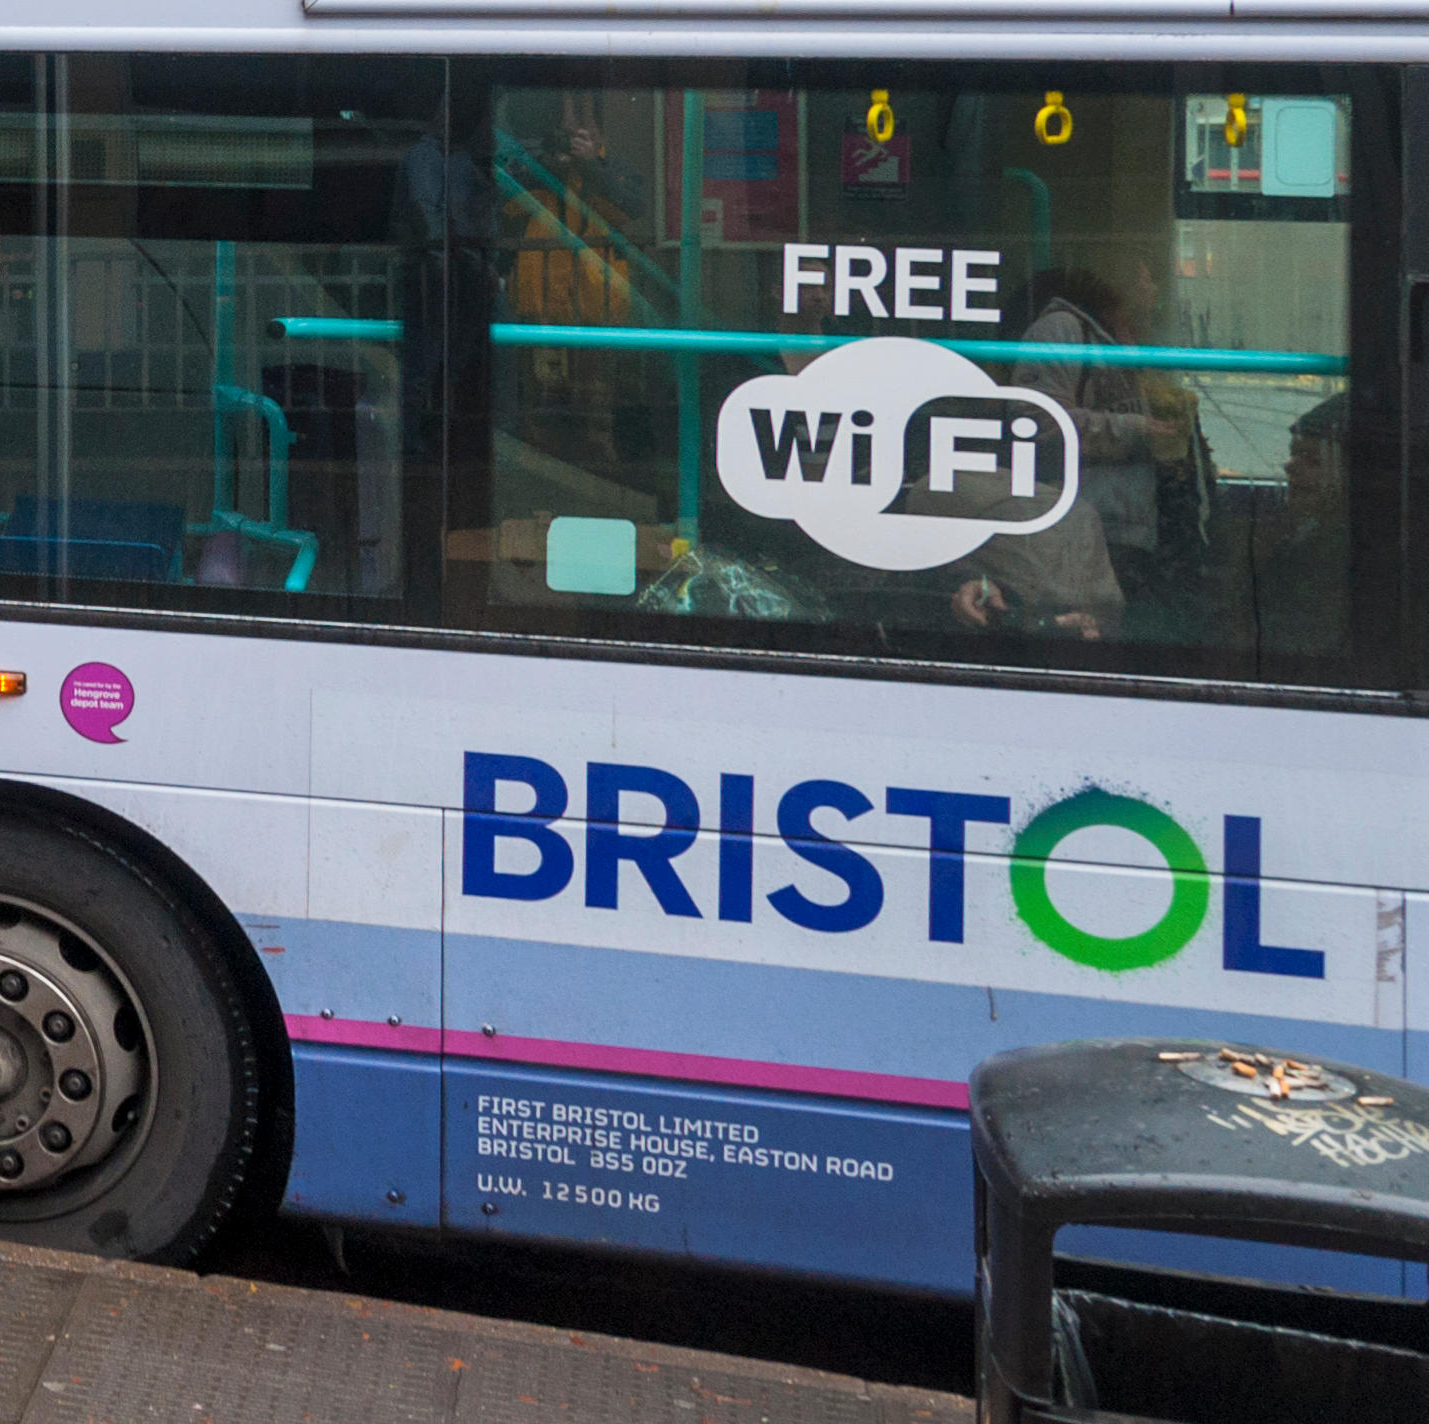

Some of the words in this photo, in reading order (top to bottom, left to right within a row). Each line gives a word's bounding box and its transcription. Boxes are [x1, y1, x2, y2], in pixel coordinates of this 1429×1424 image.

[783, 243, 1001, 323] FREE
[70, 698, 98, 709] depot
[100, 700, 124, 710] team
[73, 688, 120, 700] Hengrove
[461, 750, 1326, 980] BRISTOL
[478, 1096, 546, 1120] FIRST
[552, 1104, 653, 1131] BRISTOL
[659, 1116, 760, 1144] LIMITED
[478, 1117, 622, 1150] ENTERPRISE
[630, 1134, 715, 1163] HOUSE,
[723, 1146, 818, 1174] EASTON
[826, 1156, 894, 1181] ROAD
[478, 1138, 577, 1166] BRISTOL
[590, 1149, 634, 1172] BS5
[478, 1174, 528, 1196] U.W.
[628, 1192, 660, 1212] KG
